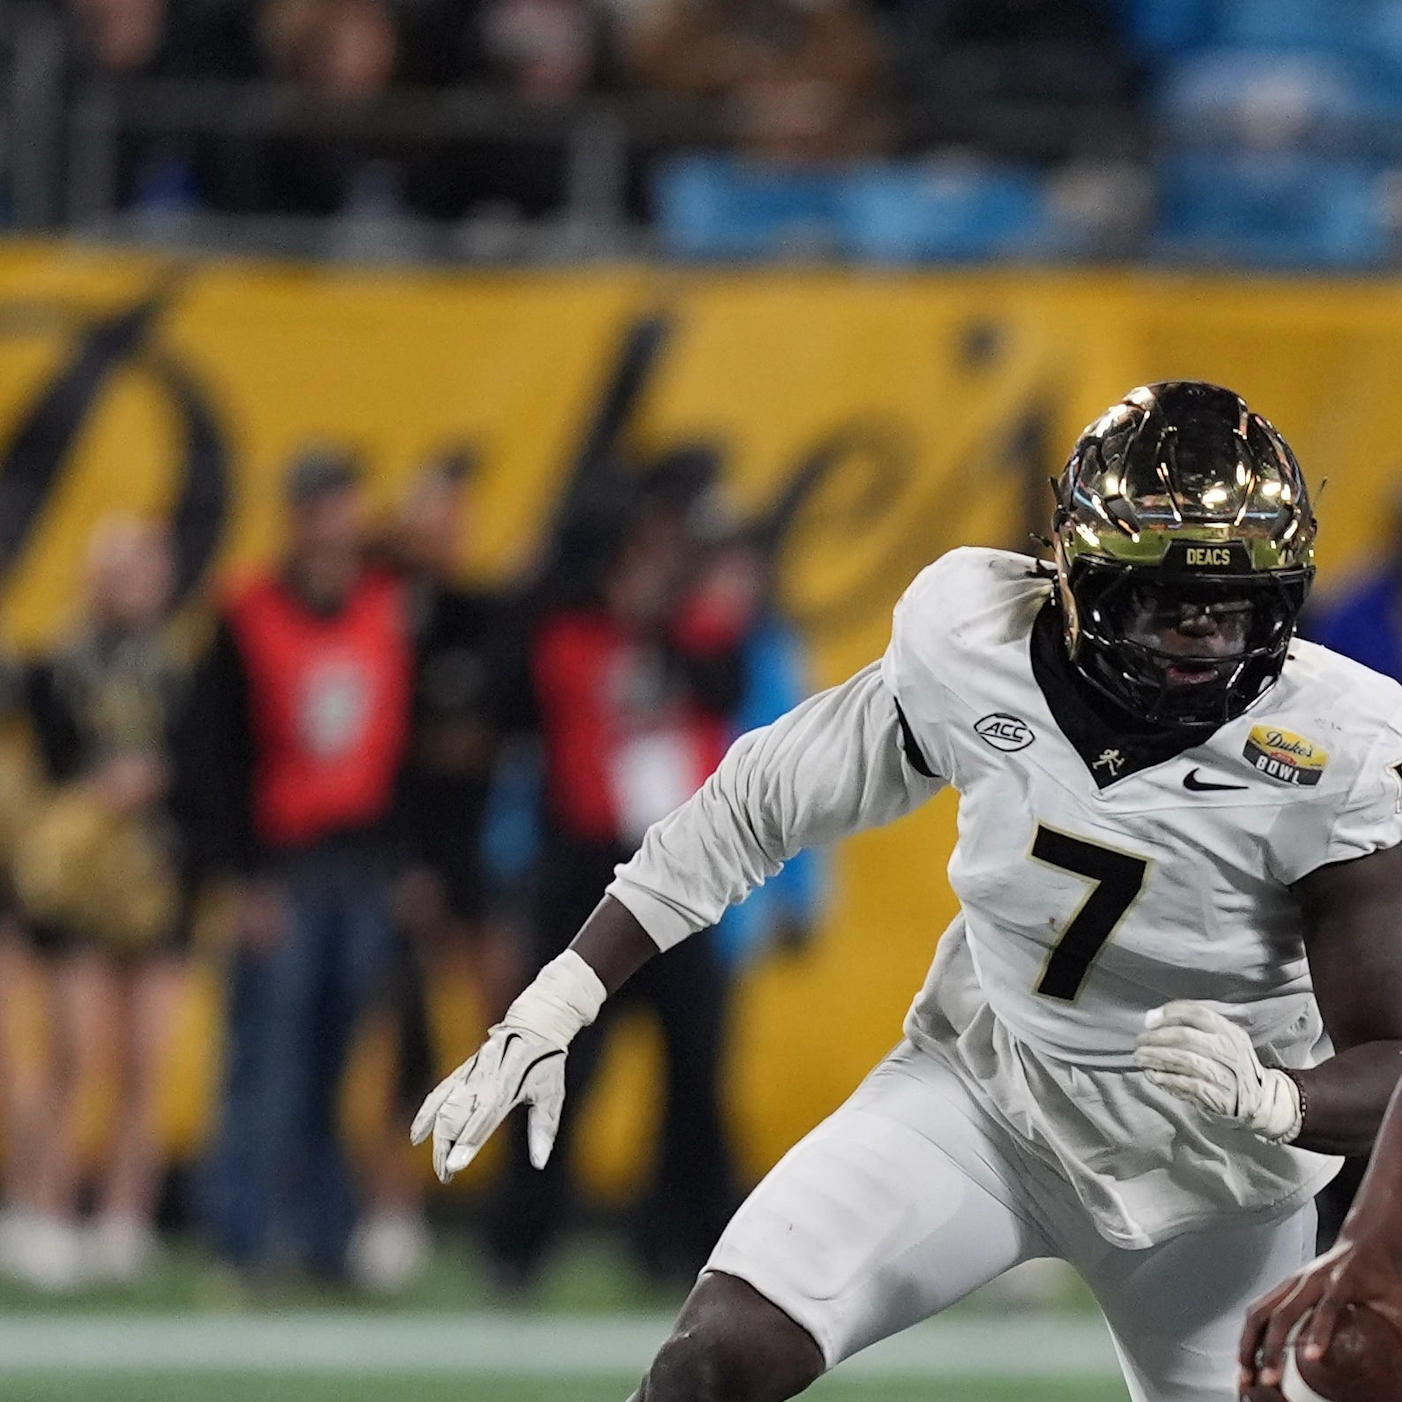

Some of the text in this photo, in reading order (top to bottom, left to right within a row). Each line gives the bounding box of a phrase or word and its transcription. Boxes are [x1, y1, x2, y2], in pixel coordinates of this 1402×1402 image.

[0, 280, 1062, 630] Dke's
[1186, 548, 1231, 566] DEACS
[984, 722, 1027, 740] ACC
[1266, 731, 1314, 759] Duke's
[1256, 755, 1301, 785] BOWL
[1030, 822, 1150, 1002] 7
